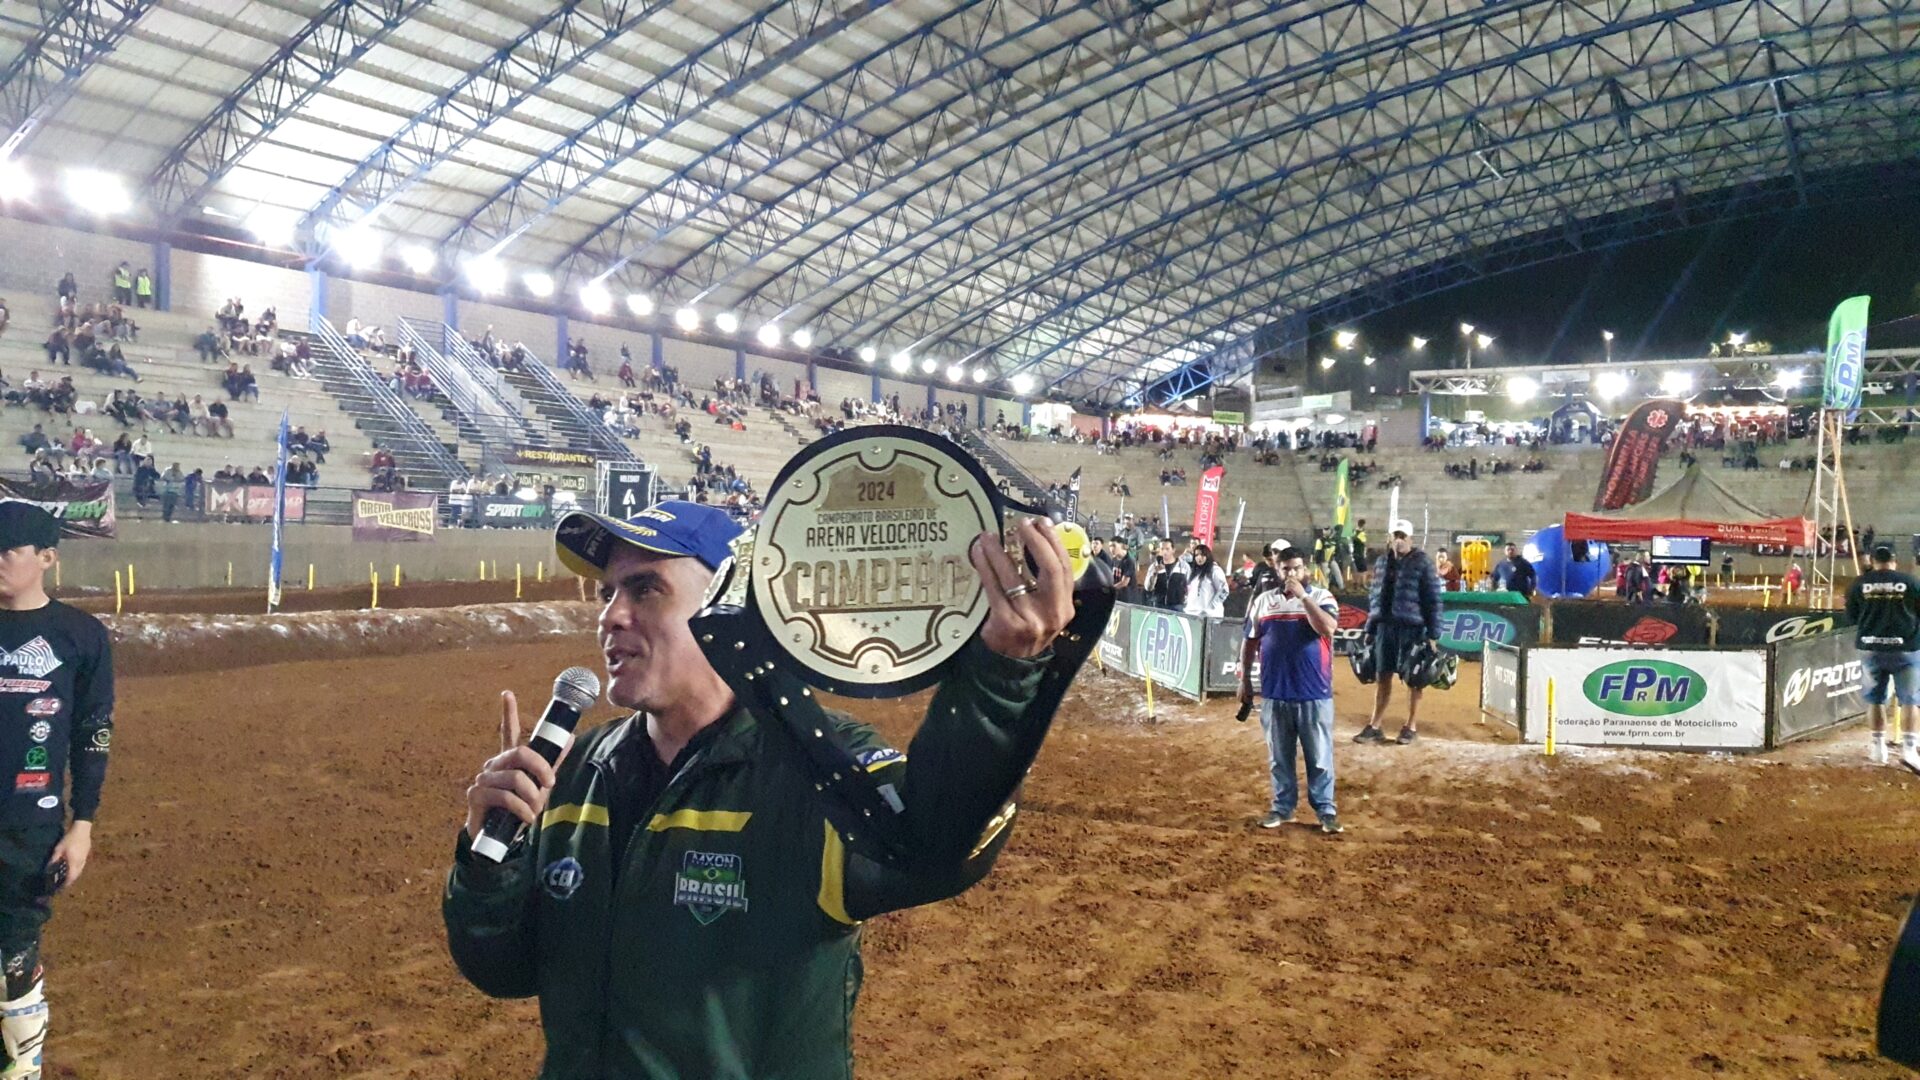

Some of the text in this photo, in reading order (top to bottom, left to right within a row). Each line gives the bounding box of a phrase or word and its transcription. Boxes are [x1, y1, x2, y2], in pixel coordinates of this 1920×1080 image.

[524, 450, 587, 463] RESTAURANTE
[858, 481, 897, 501] 2024
[360, 501, 391, 515] ARENA
[926, 508, 937, 520] DE
[1198, 497, 1210, 533] STORE
[379, 510, 432, 531] VELOCROSS
[806, 521, 948, 548] ARENA VELOCROSS
[1603, 718, 1657, 727] Paranaense
[1660, 719, 1671, 727] de
[1674, 719, 1738, 728] Motociclismo
[1603, 730, 1685, 738] www.fprm.com.br
[679, 877, 743, 908] BRASIL
